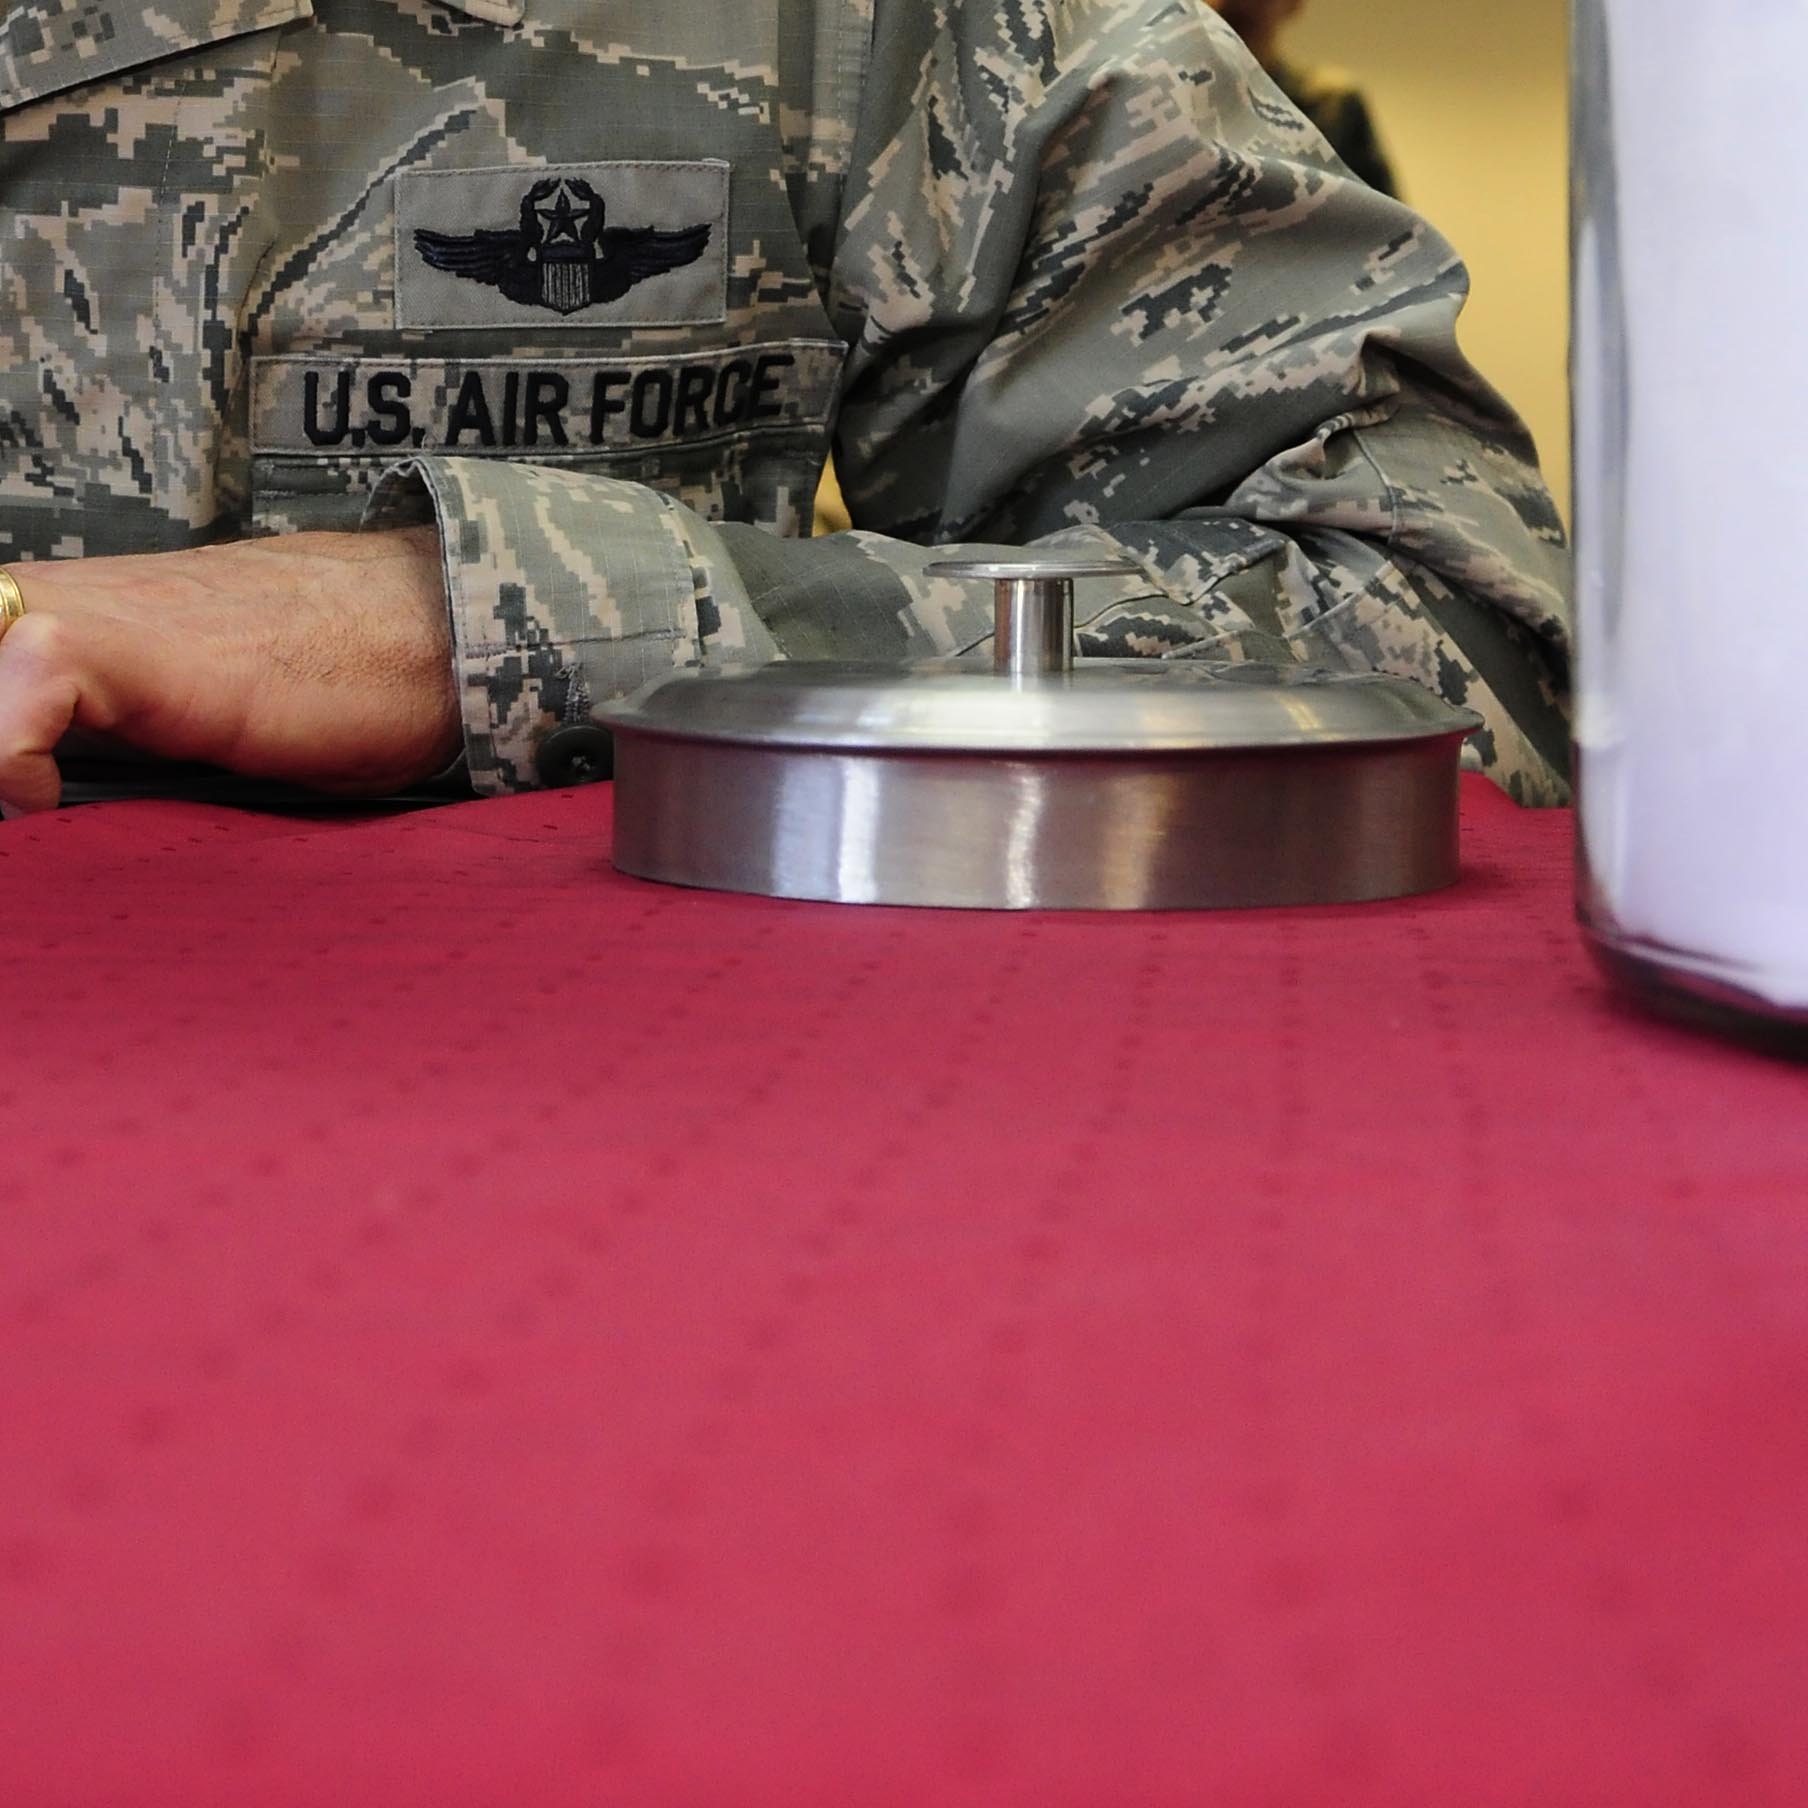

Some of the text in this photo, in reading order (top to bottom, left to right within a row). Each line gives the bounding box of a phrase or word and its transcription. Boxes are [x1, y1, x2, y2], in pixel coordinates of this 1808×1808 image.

[304, 354, 796, 448] U.S. AIR FORCE
